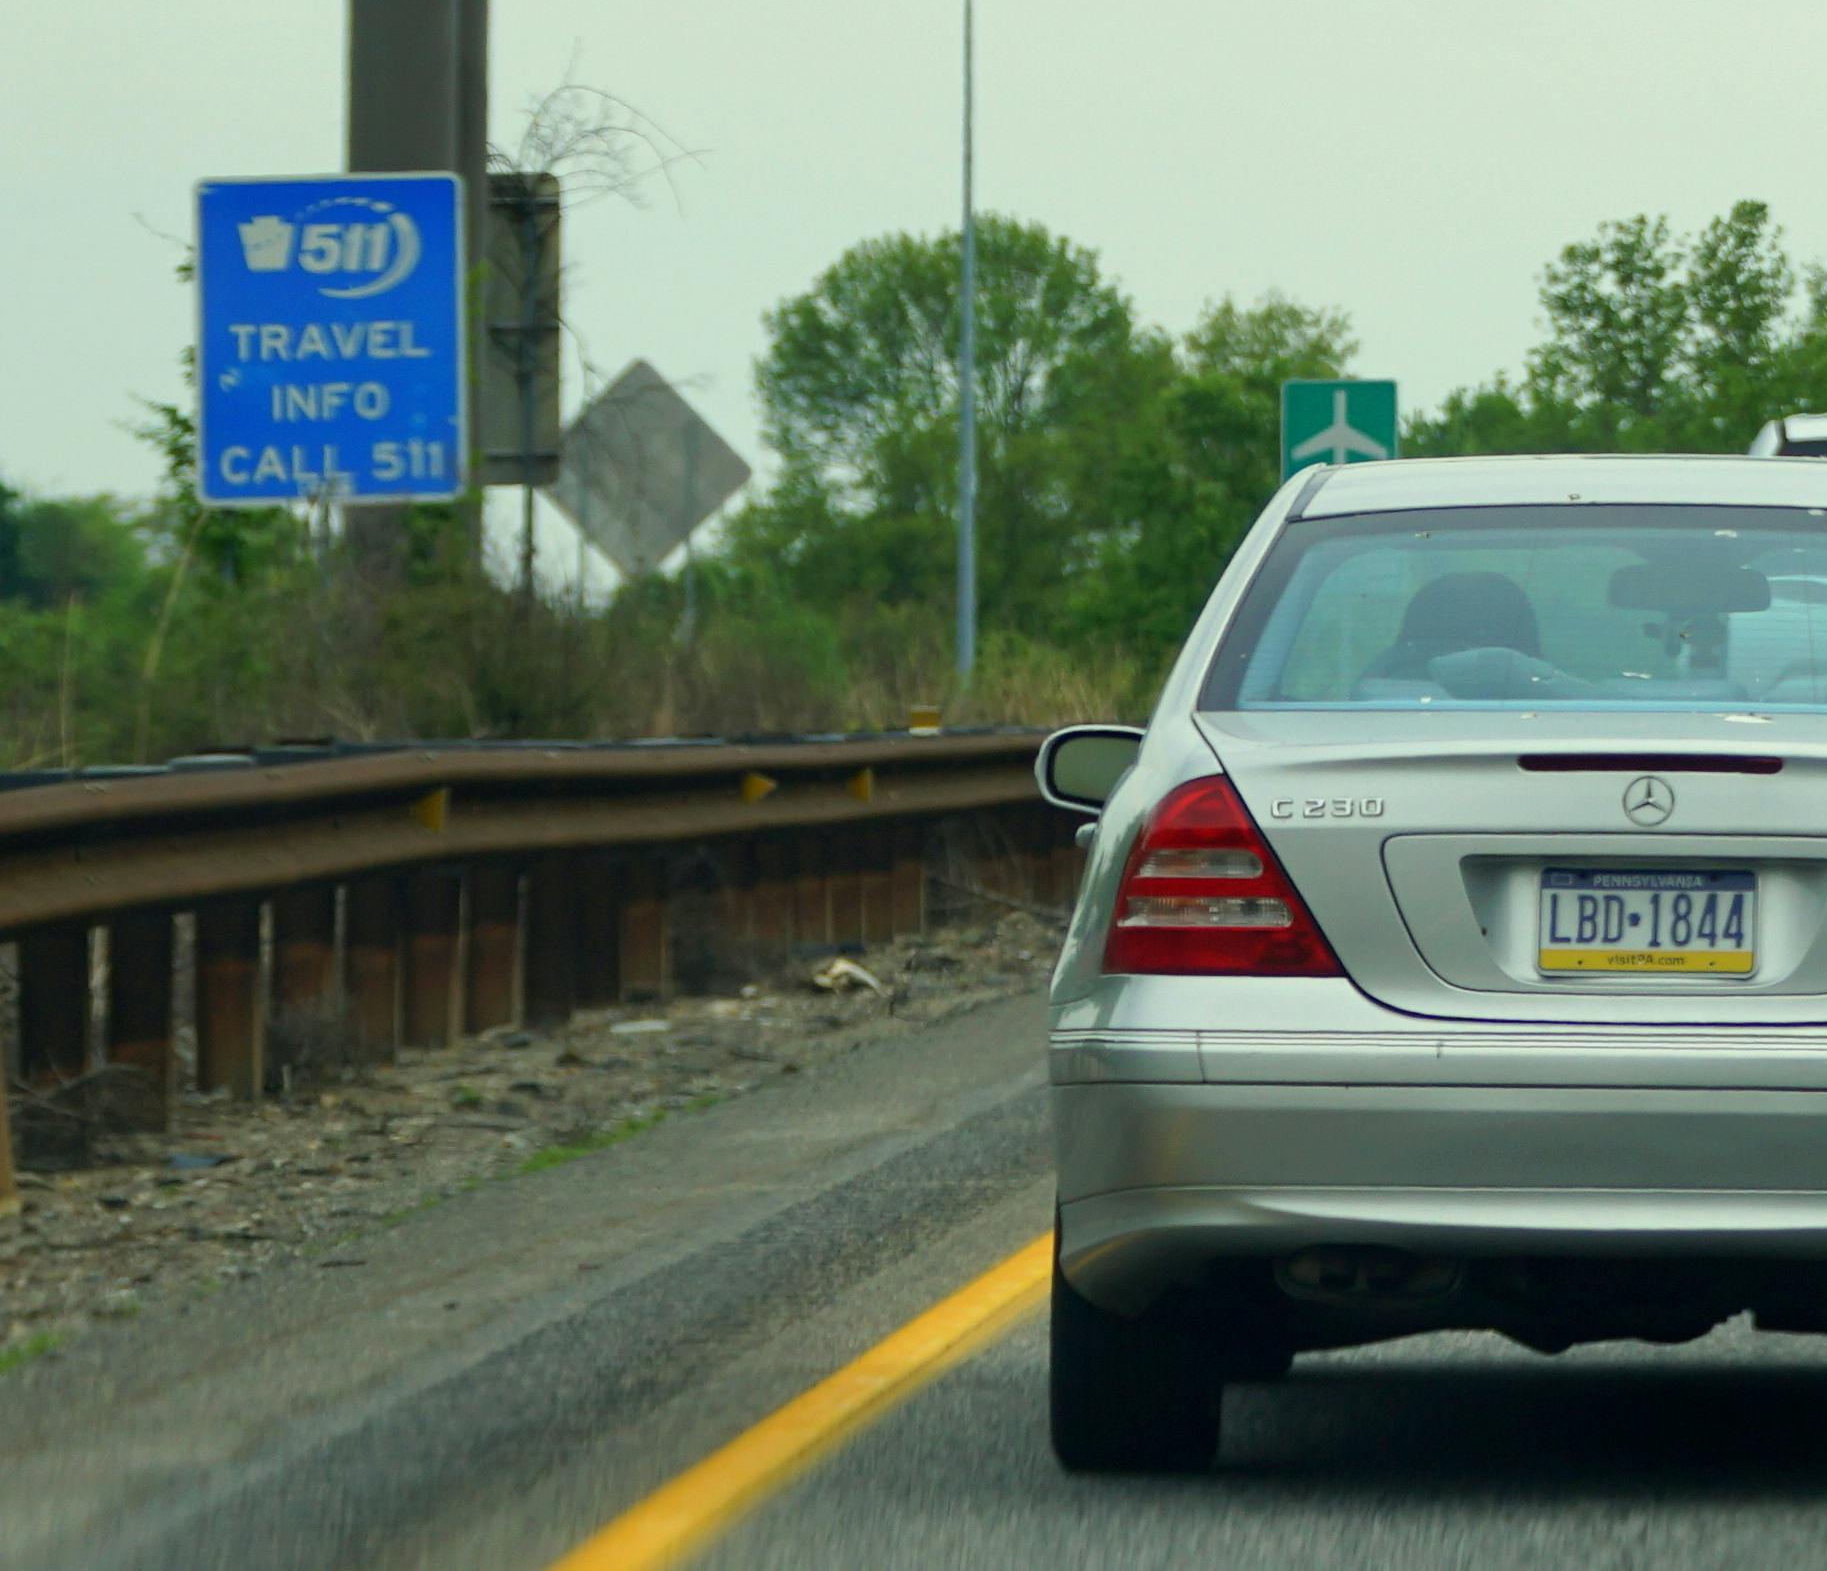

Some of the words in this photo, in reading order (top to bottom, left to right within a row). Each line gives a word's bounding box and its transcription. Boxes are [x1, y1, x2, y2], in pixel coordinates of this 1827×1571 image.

[297, 225, 391, 273] 511
[229, 321, 430, 360] TRAVEL
[271, 383, 391, 422] INFO
[220, 443, 352, 482] CALL
[372, 441, 446, 479] 511
[1271, 799, 1293, 819] C
[1303, 797, 1384, 818] 230
[1593, 874, 1702, 888] PENNSYLVANIA
[1607, 954, 1685, 966] visitPA.com
